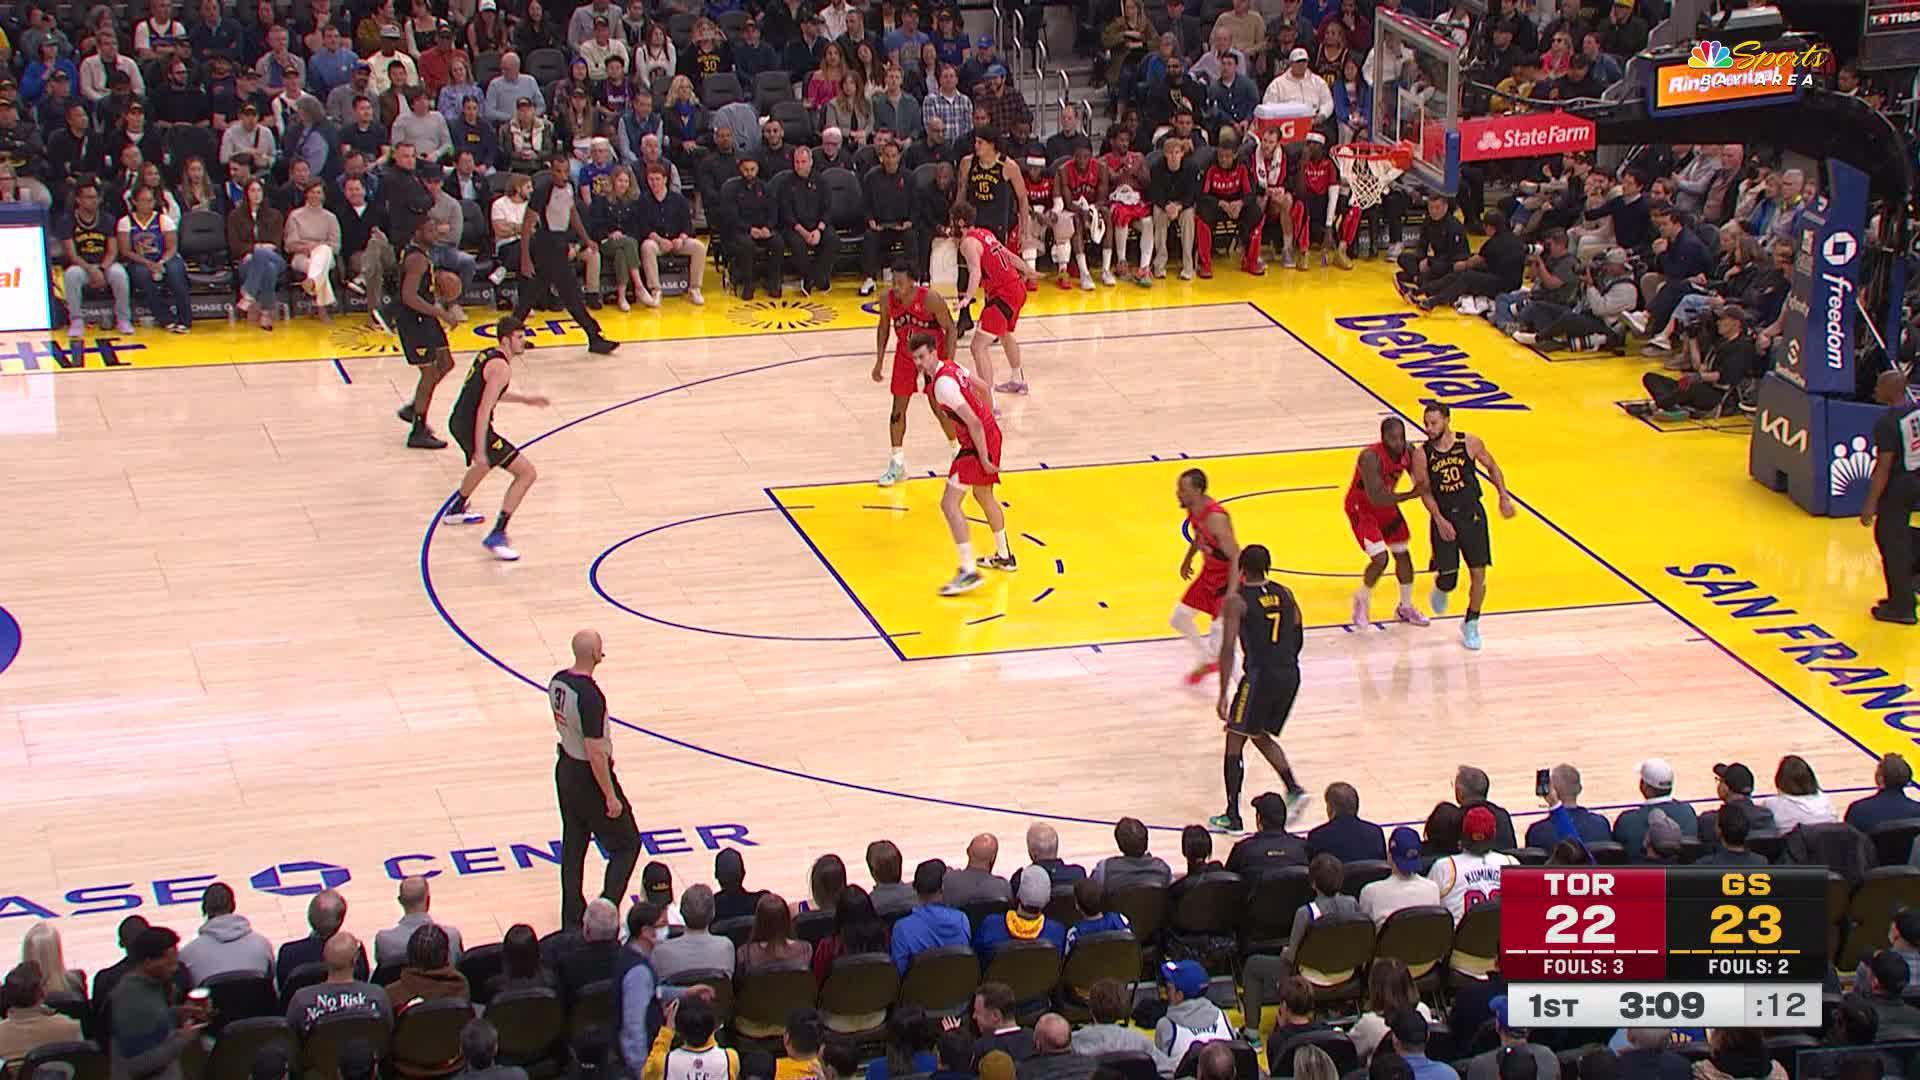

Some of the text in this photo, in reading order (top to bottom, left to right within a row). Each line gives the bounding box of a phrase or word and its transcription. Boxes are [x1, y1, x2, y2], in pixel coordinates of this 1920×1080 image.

[703, 60, 717, 72] 30
[1281, 122, 1294, 139] G
[1822, 273, 1853, 369] freedom
[1334, 312, 1531, 411] betway
[1432, 456, 1465, 472] GOLDEN
[1440, 466, 1460, 483] 30
[1440, 481, 1465, 492] STATE
[1265, 612, 1280, 642] 7
[1664, 563, 1920, 744] SAN FRANC
[384, 823, 760, 881] CENER
[317, 992, 366, 1009] No Risk
